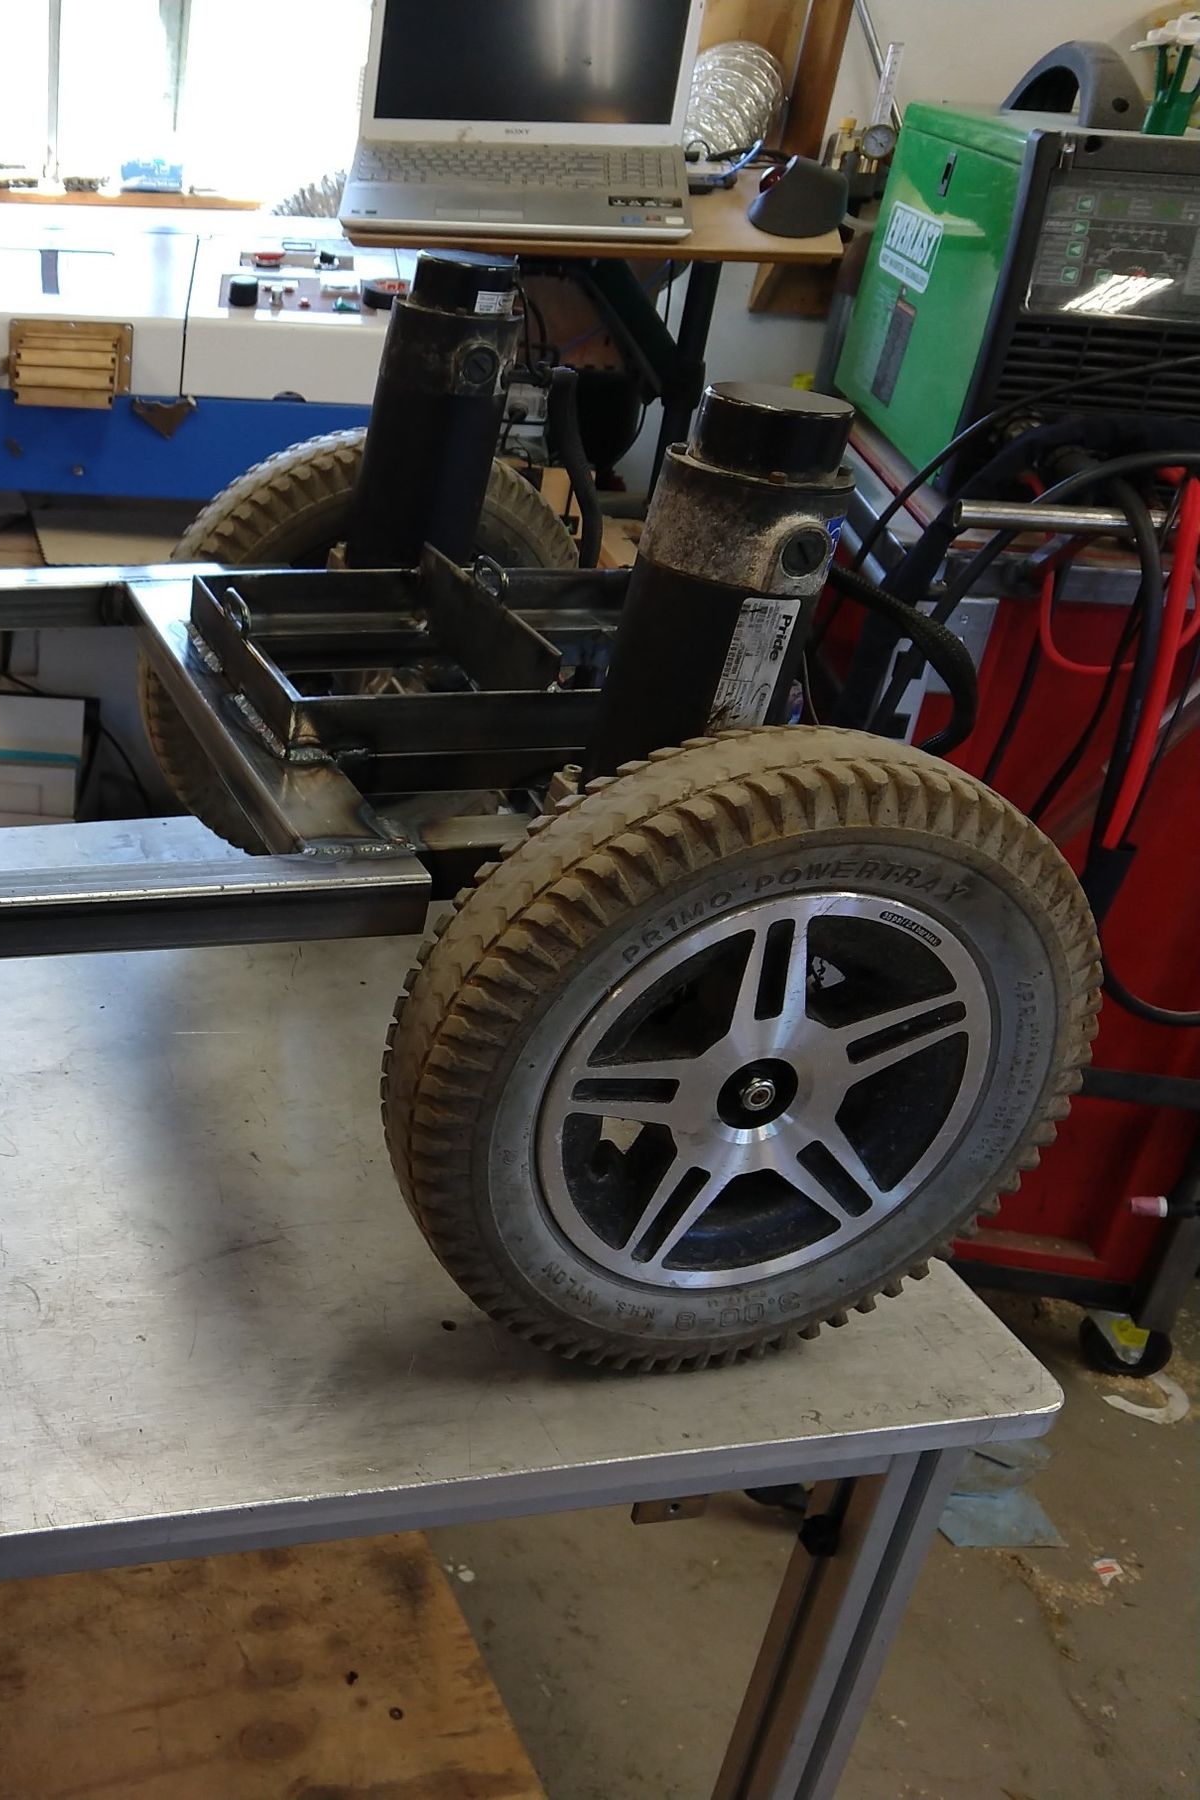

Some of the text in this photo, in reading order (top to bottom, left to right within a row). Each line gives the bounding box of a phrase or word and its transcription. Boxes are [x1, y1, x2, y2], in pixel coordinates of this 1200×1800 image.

[505, 128, 530, 136] SONY
[886, 207, 941, 267] EVERLAST
[769, 614, 793, 661] Pride
[676, 1291, 801, 1331] 3.00-8
